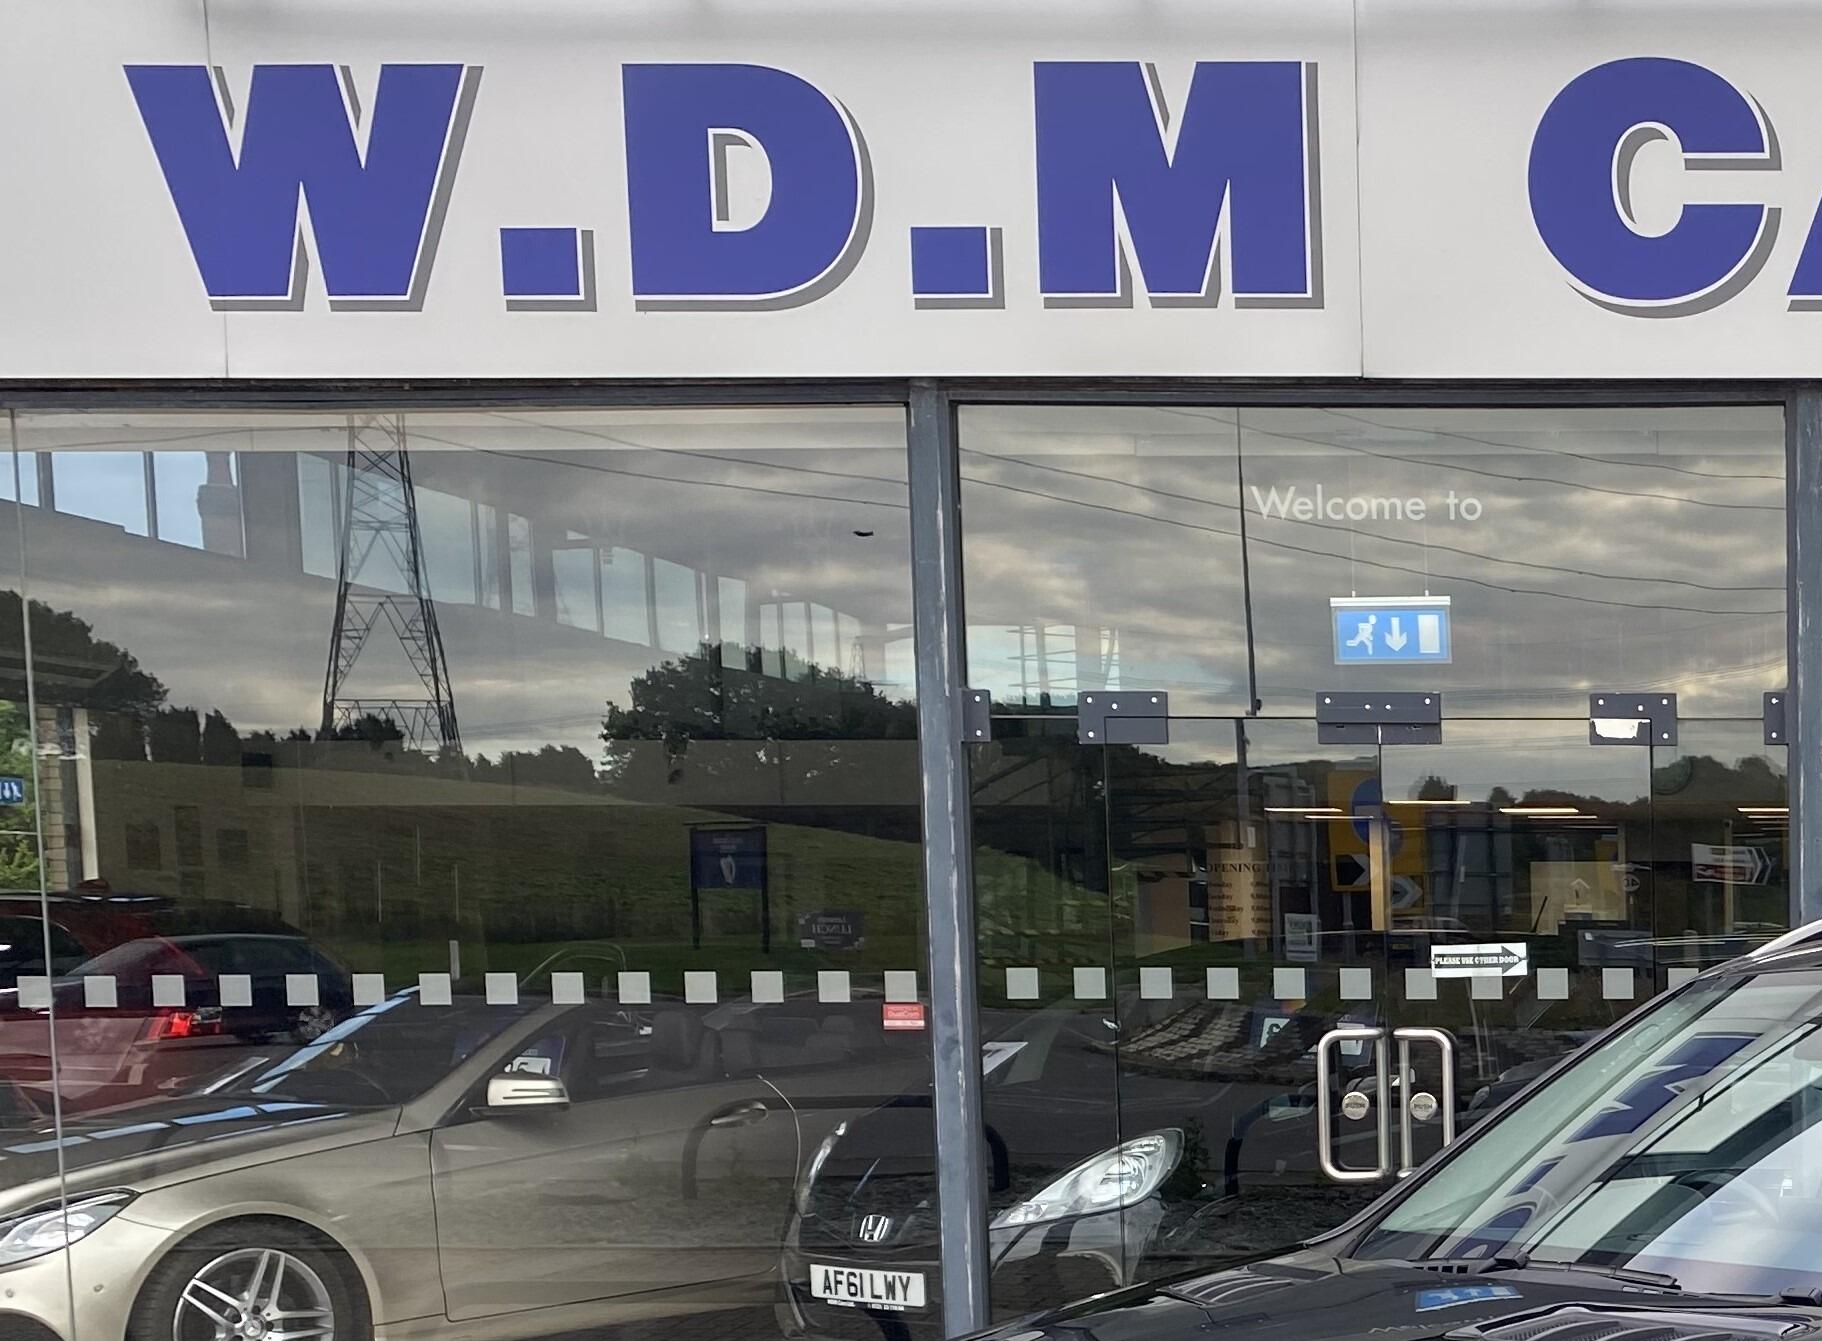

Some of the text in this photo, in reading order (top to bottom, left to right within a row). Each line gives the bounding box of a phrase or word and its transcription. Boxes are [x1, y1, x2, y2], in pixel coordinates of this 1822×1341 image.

[122, 60, 1324, 312] W.D.M
[1250, 483, 1483, 521] Welcome to
[1207, 863, 1261, 873] OPENING
[1434, 955, 1519, 965] PLEASE USE OTHER DOOR
[823, 1269, 911, 1302] AF61 LWY
